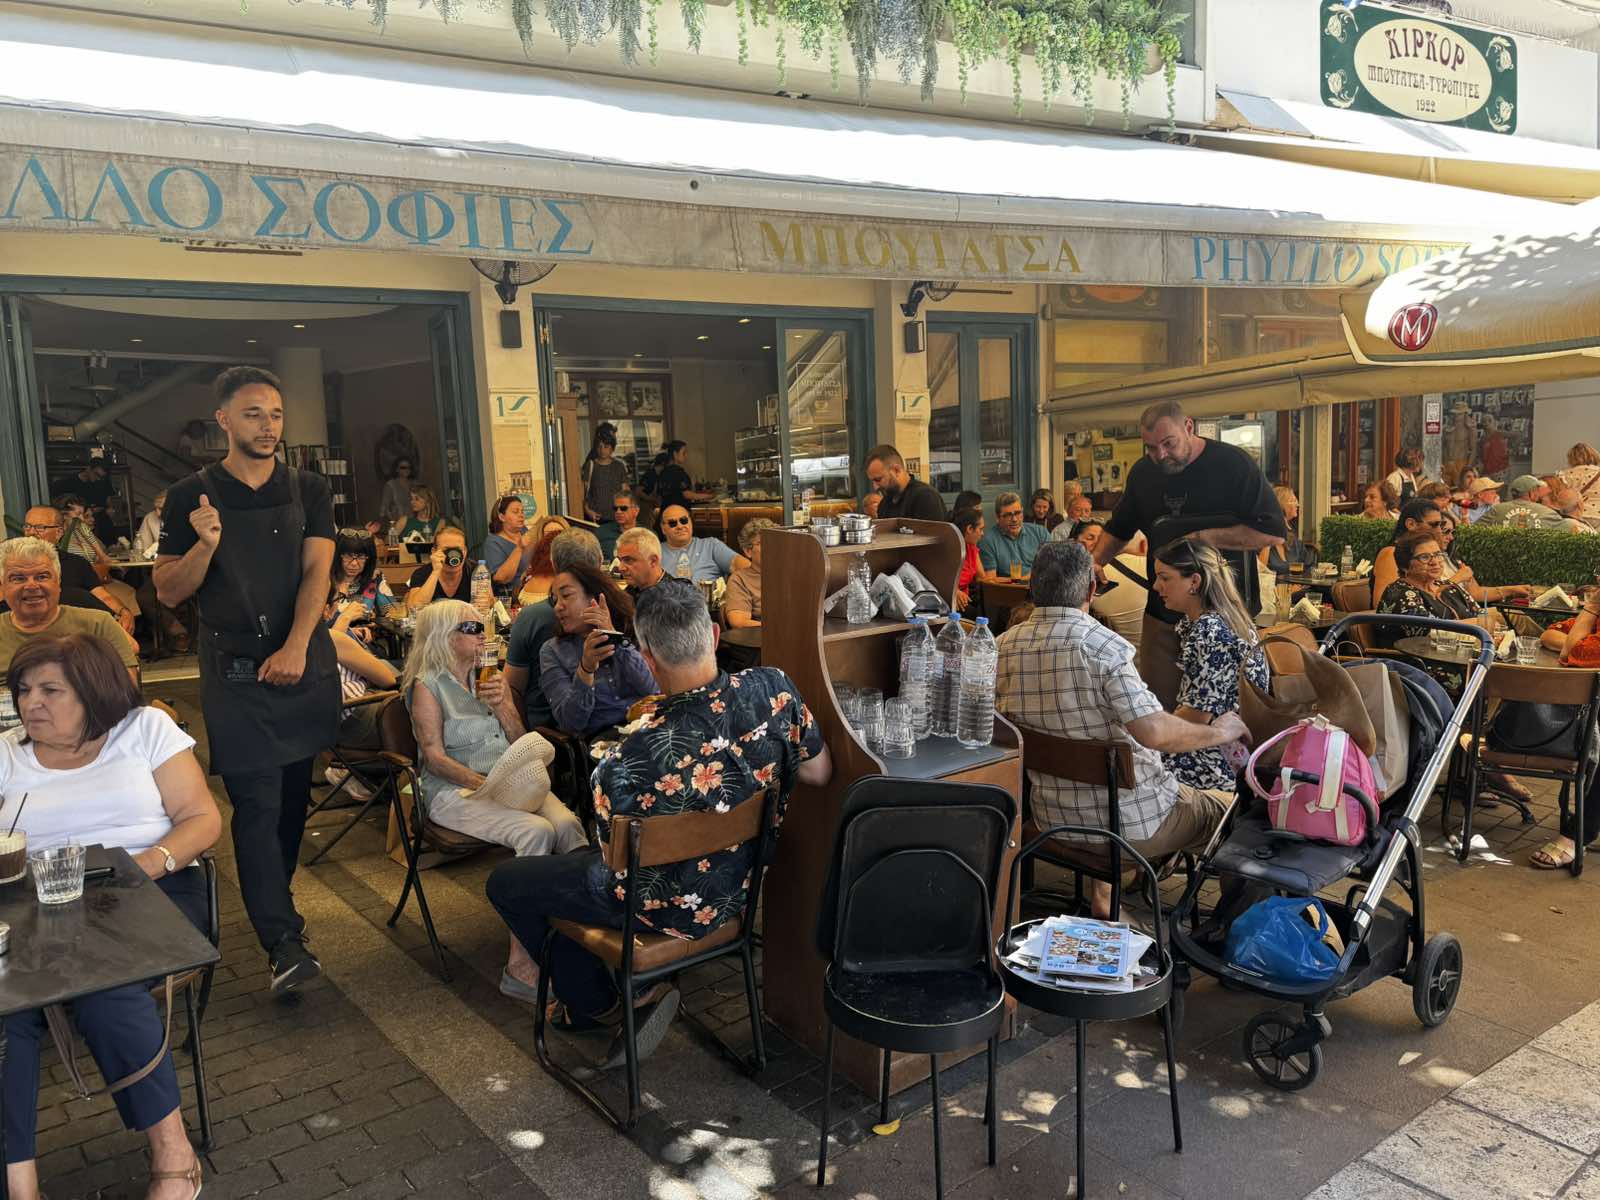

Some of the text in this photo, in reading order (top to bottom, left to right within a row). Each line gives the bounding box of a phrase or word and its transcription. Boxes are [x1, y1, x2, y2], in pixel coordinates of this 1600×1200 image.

[1384, 28, 1465, 71] ΚΙΡΚΟΡ
[1416, 98, 1436, 113] 1922
[250, 175, 594, 255] ΣΟΦΙΕΣ
[1191, 235, 1365, 284] PHYLLO
